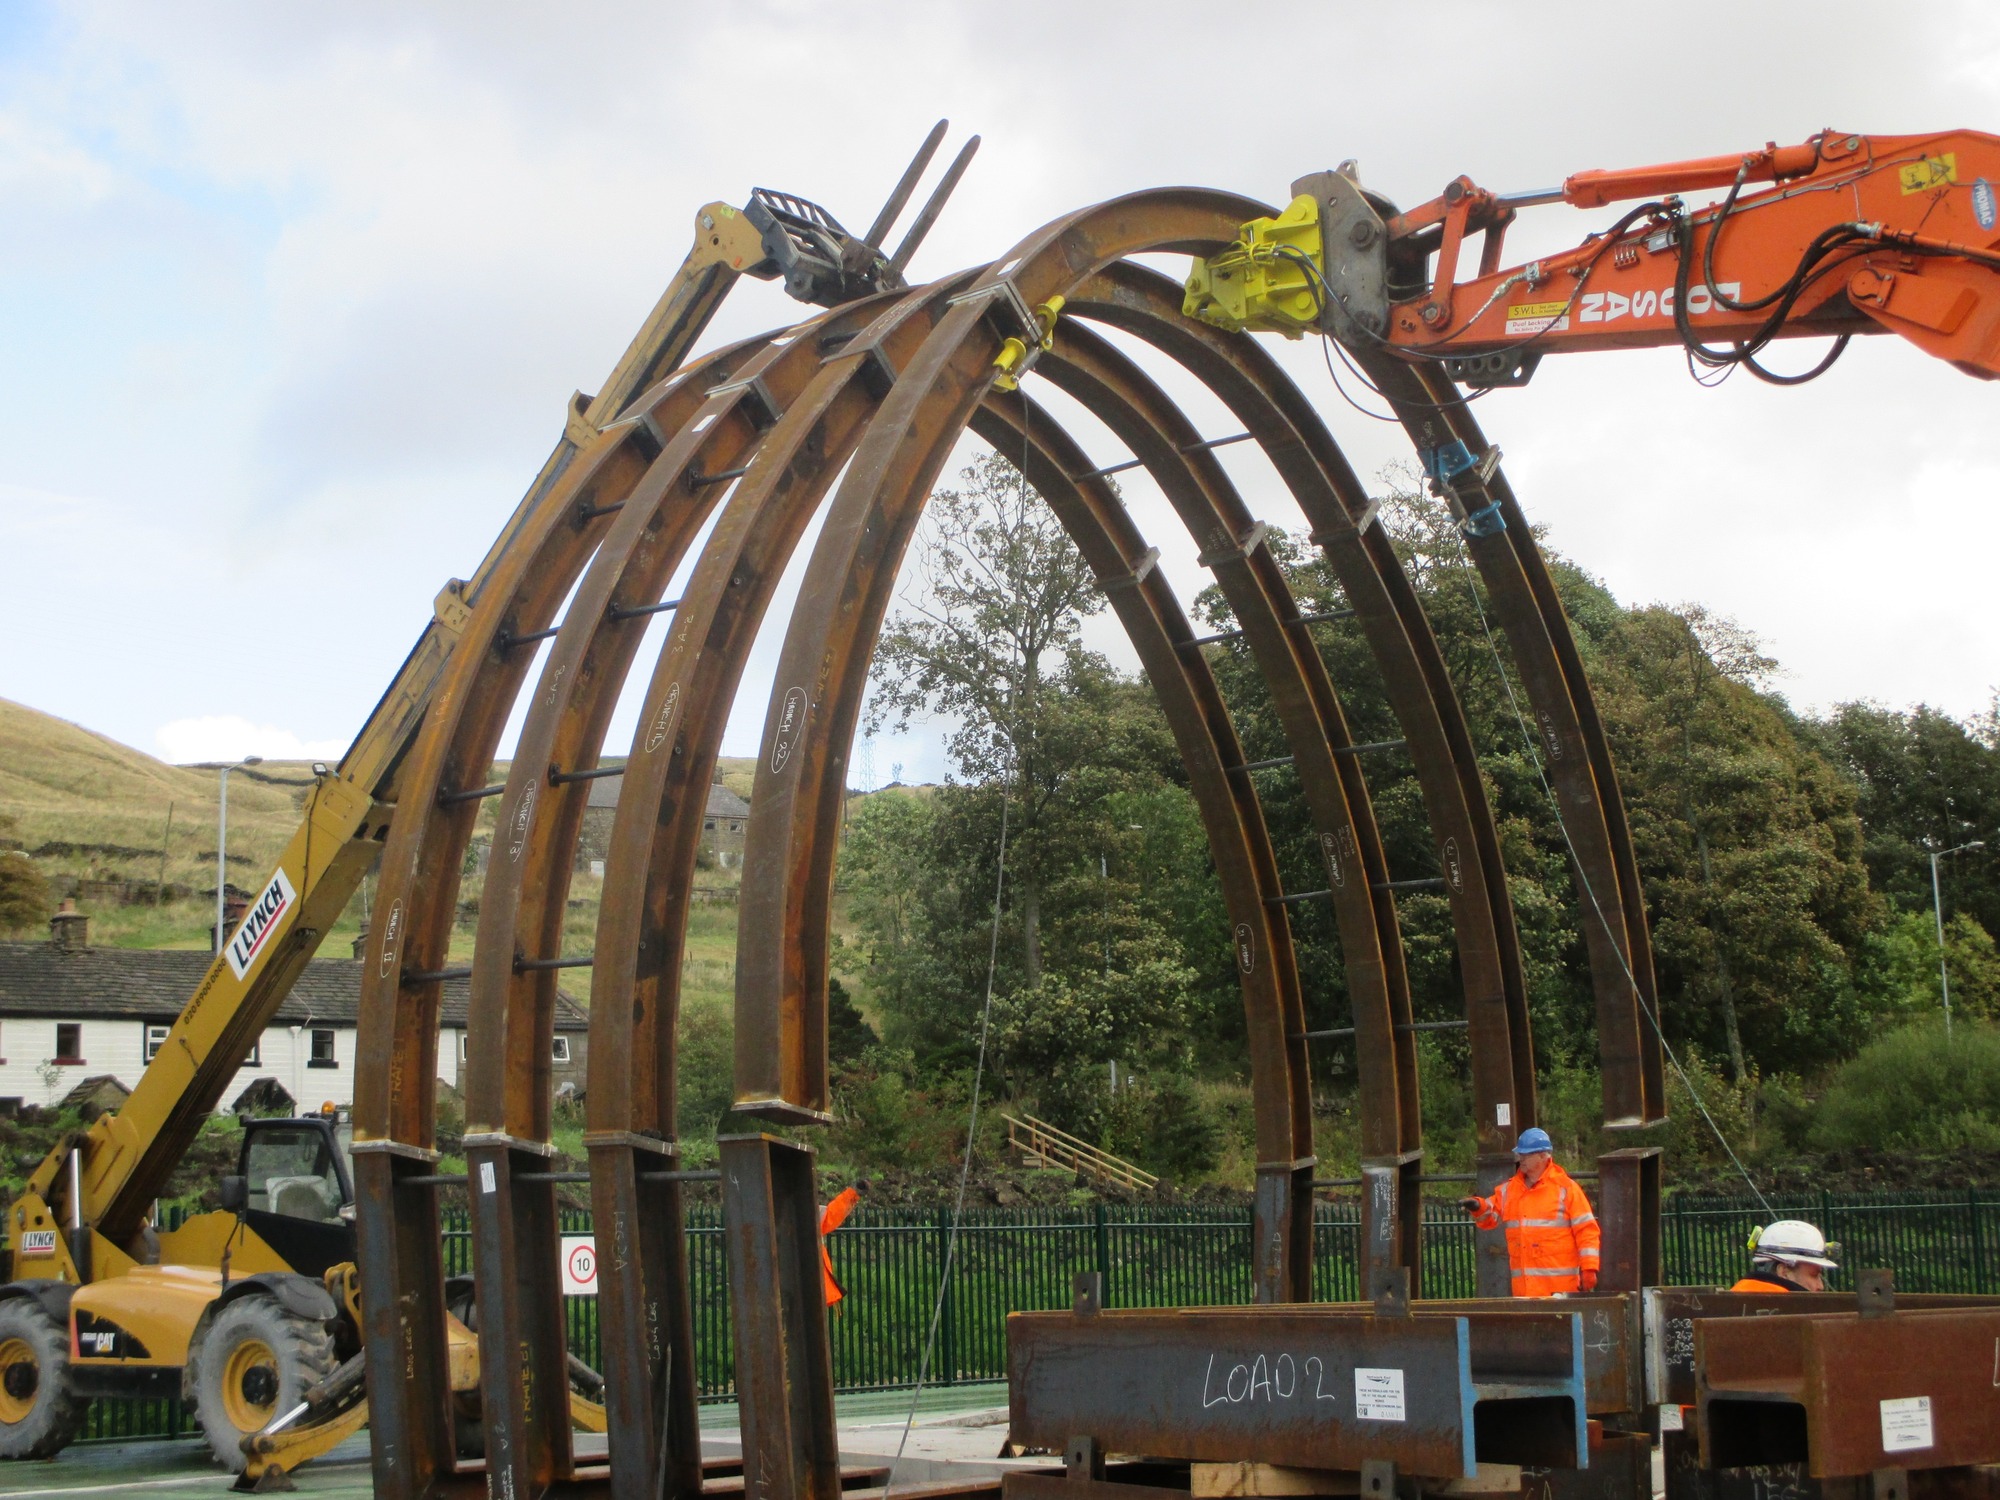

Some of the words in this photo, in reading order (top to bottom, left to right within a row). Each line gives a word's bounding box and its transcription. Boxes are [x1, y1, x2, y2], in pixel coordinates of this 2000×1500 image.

[1974, 183, 1993, 225] PROMAC
[774, 741, 788, 767] 22
[241, 879, 285, 952] LYNCH
[184, 1006, 198, 1025] 020
[196, 983, 212, 1008] 8900
[211, 958, 227, 983] 0000
[29, 1232, 55, 1246] LYNCH
[577, 1258, 590, 1271] 10
[97, 1332, 116, 1351] CAT
[405, 1353, 415, 1379] LONG
[1203, 1352, 1296, 1408] LOAD
[1305, 1356, 1335, 1400] 2
